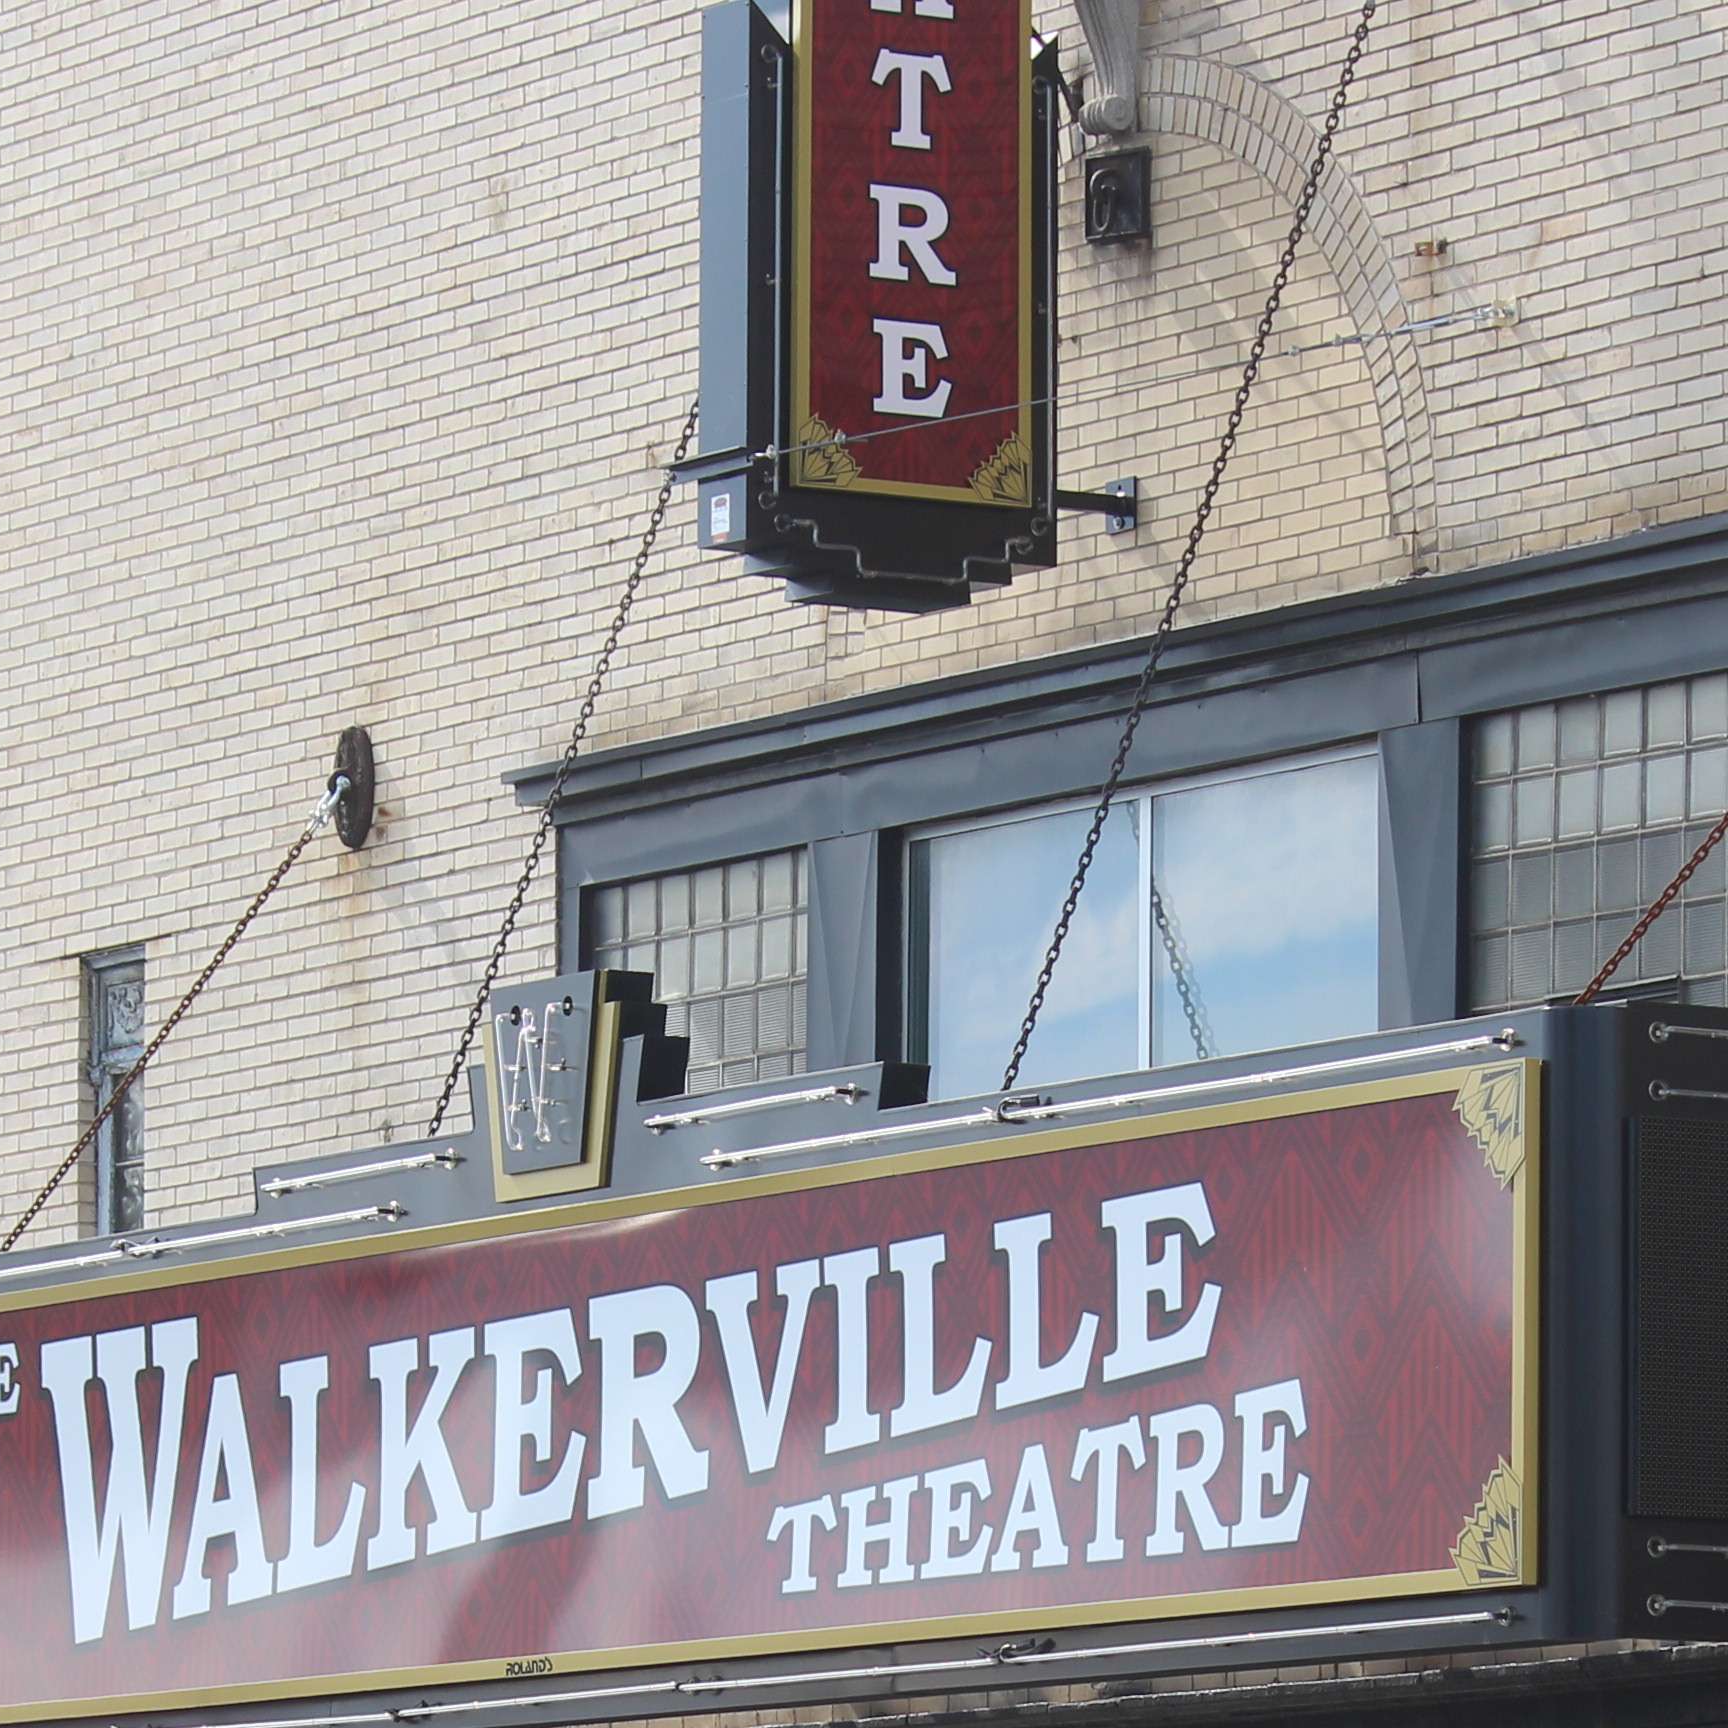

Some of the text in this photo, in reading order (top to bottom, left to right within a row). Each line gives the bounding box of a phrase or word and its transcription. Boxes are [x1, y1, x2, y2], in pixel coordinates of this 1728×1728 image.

[869, 0, 958, 420] TRE
[40, 1181, 1223, 1644] WALKERVILLE
[765, 1378, 1310, 1595] THEATRE
